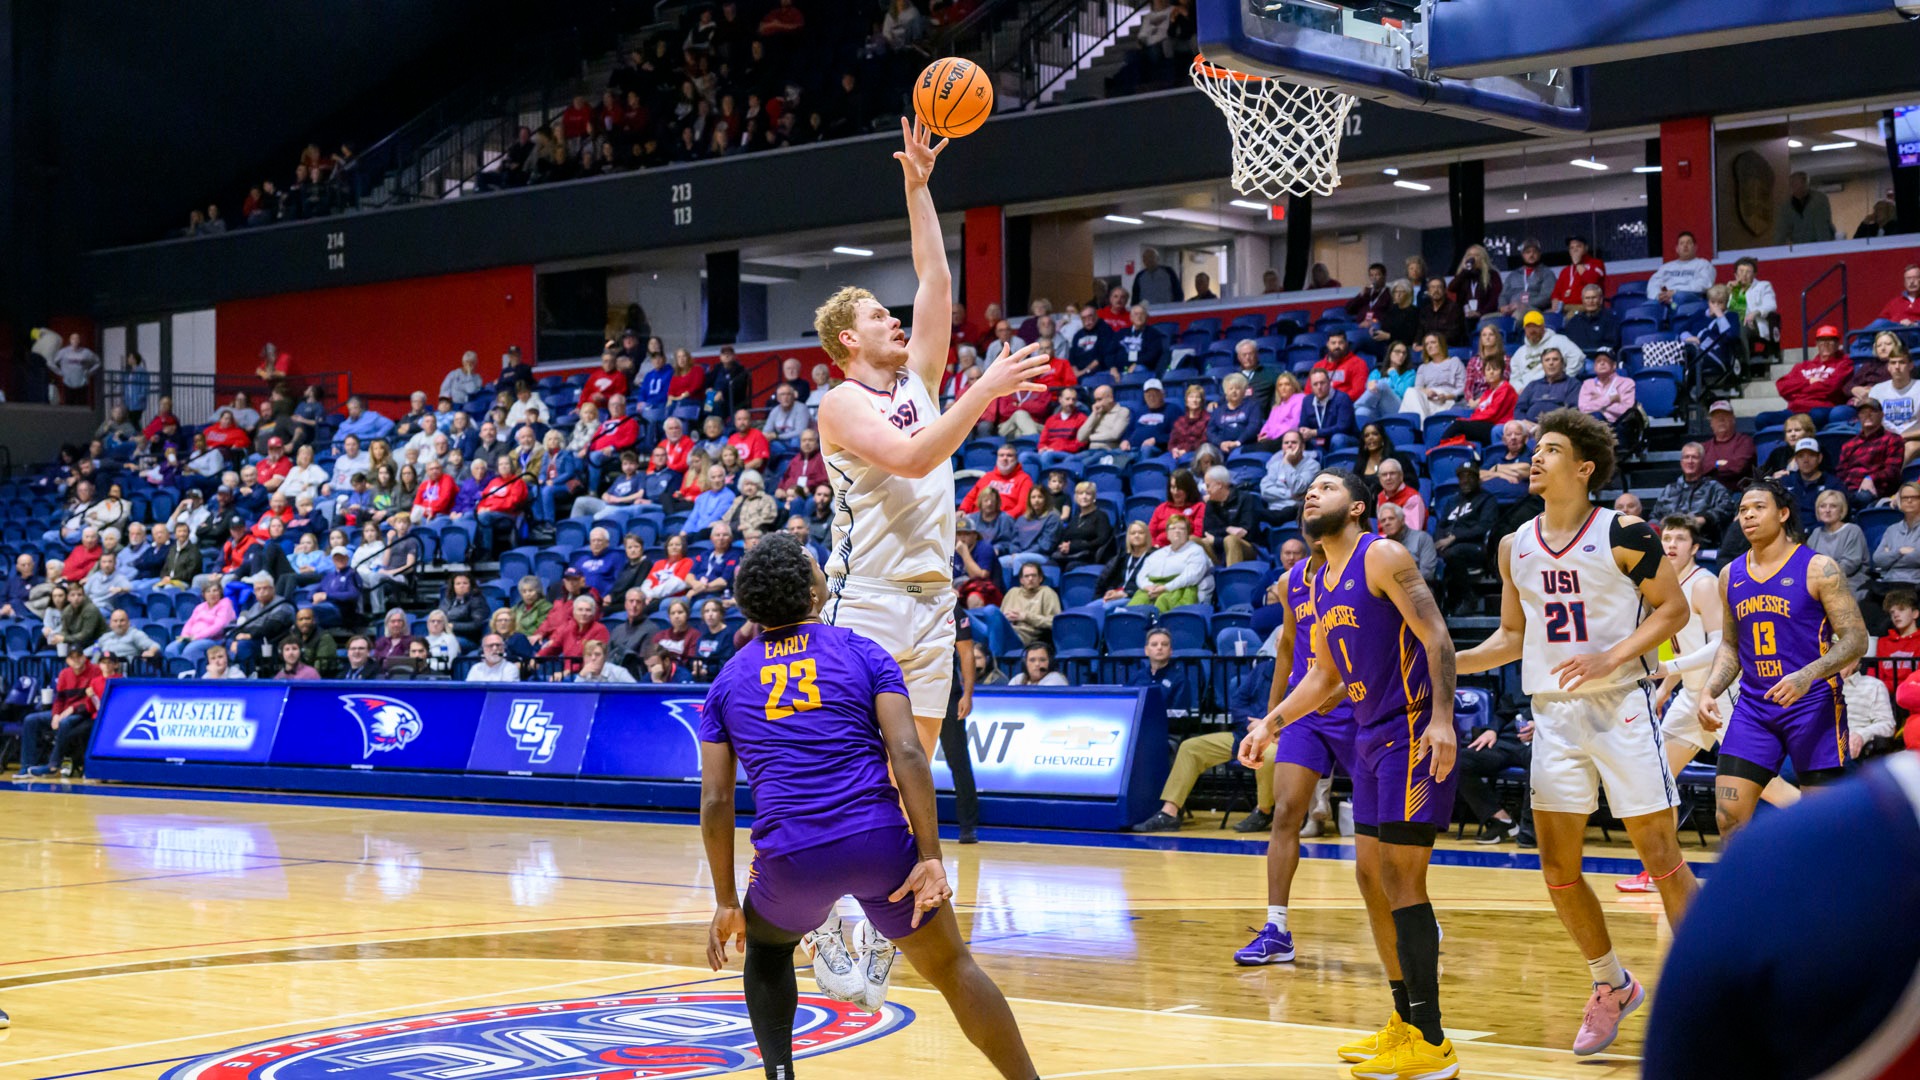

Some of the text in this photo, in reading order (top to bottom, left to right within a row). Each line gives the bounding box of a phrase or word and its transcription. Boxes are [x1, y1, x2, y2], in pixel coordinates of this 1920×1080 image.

[939, 60, 972, 100] Wilson
[671, 183, 692, 203] 213
[673, 206, 692, 225] 113
[327, 231, 344, 249] 214
[328, 253, 344, 270] 114
[1541, 570, 1581, 595] USI
[1735, 594, 1791, 621] TENNESSEE
[1544, 600, 1589, 643] 21
[765, 633, 809, 660] EARLY
[1752, 621, 1777, 656] 13
[1338, 638, 1353, 674] 1
[1755, 660, 1783, 677] TECH
[760, 658, 822, 721] 23
[159, 702, 238, 721] TRI-STATE
[160, 724, 250, 739] ORTHOPAEDICS
[508, 701, 561, 759] USI
[1034, 755, 1116, 767] CHEVROLET
[793, 1011, 874, 1046] OHIO
[345, 1008, 752, 1080] OVC
